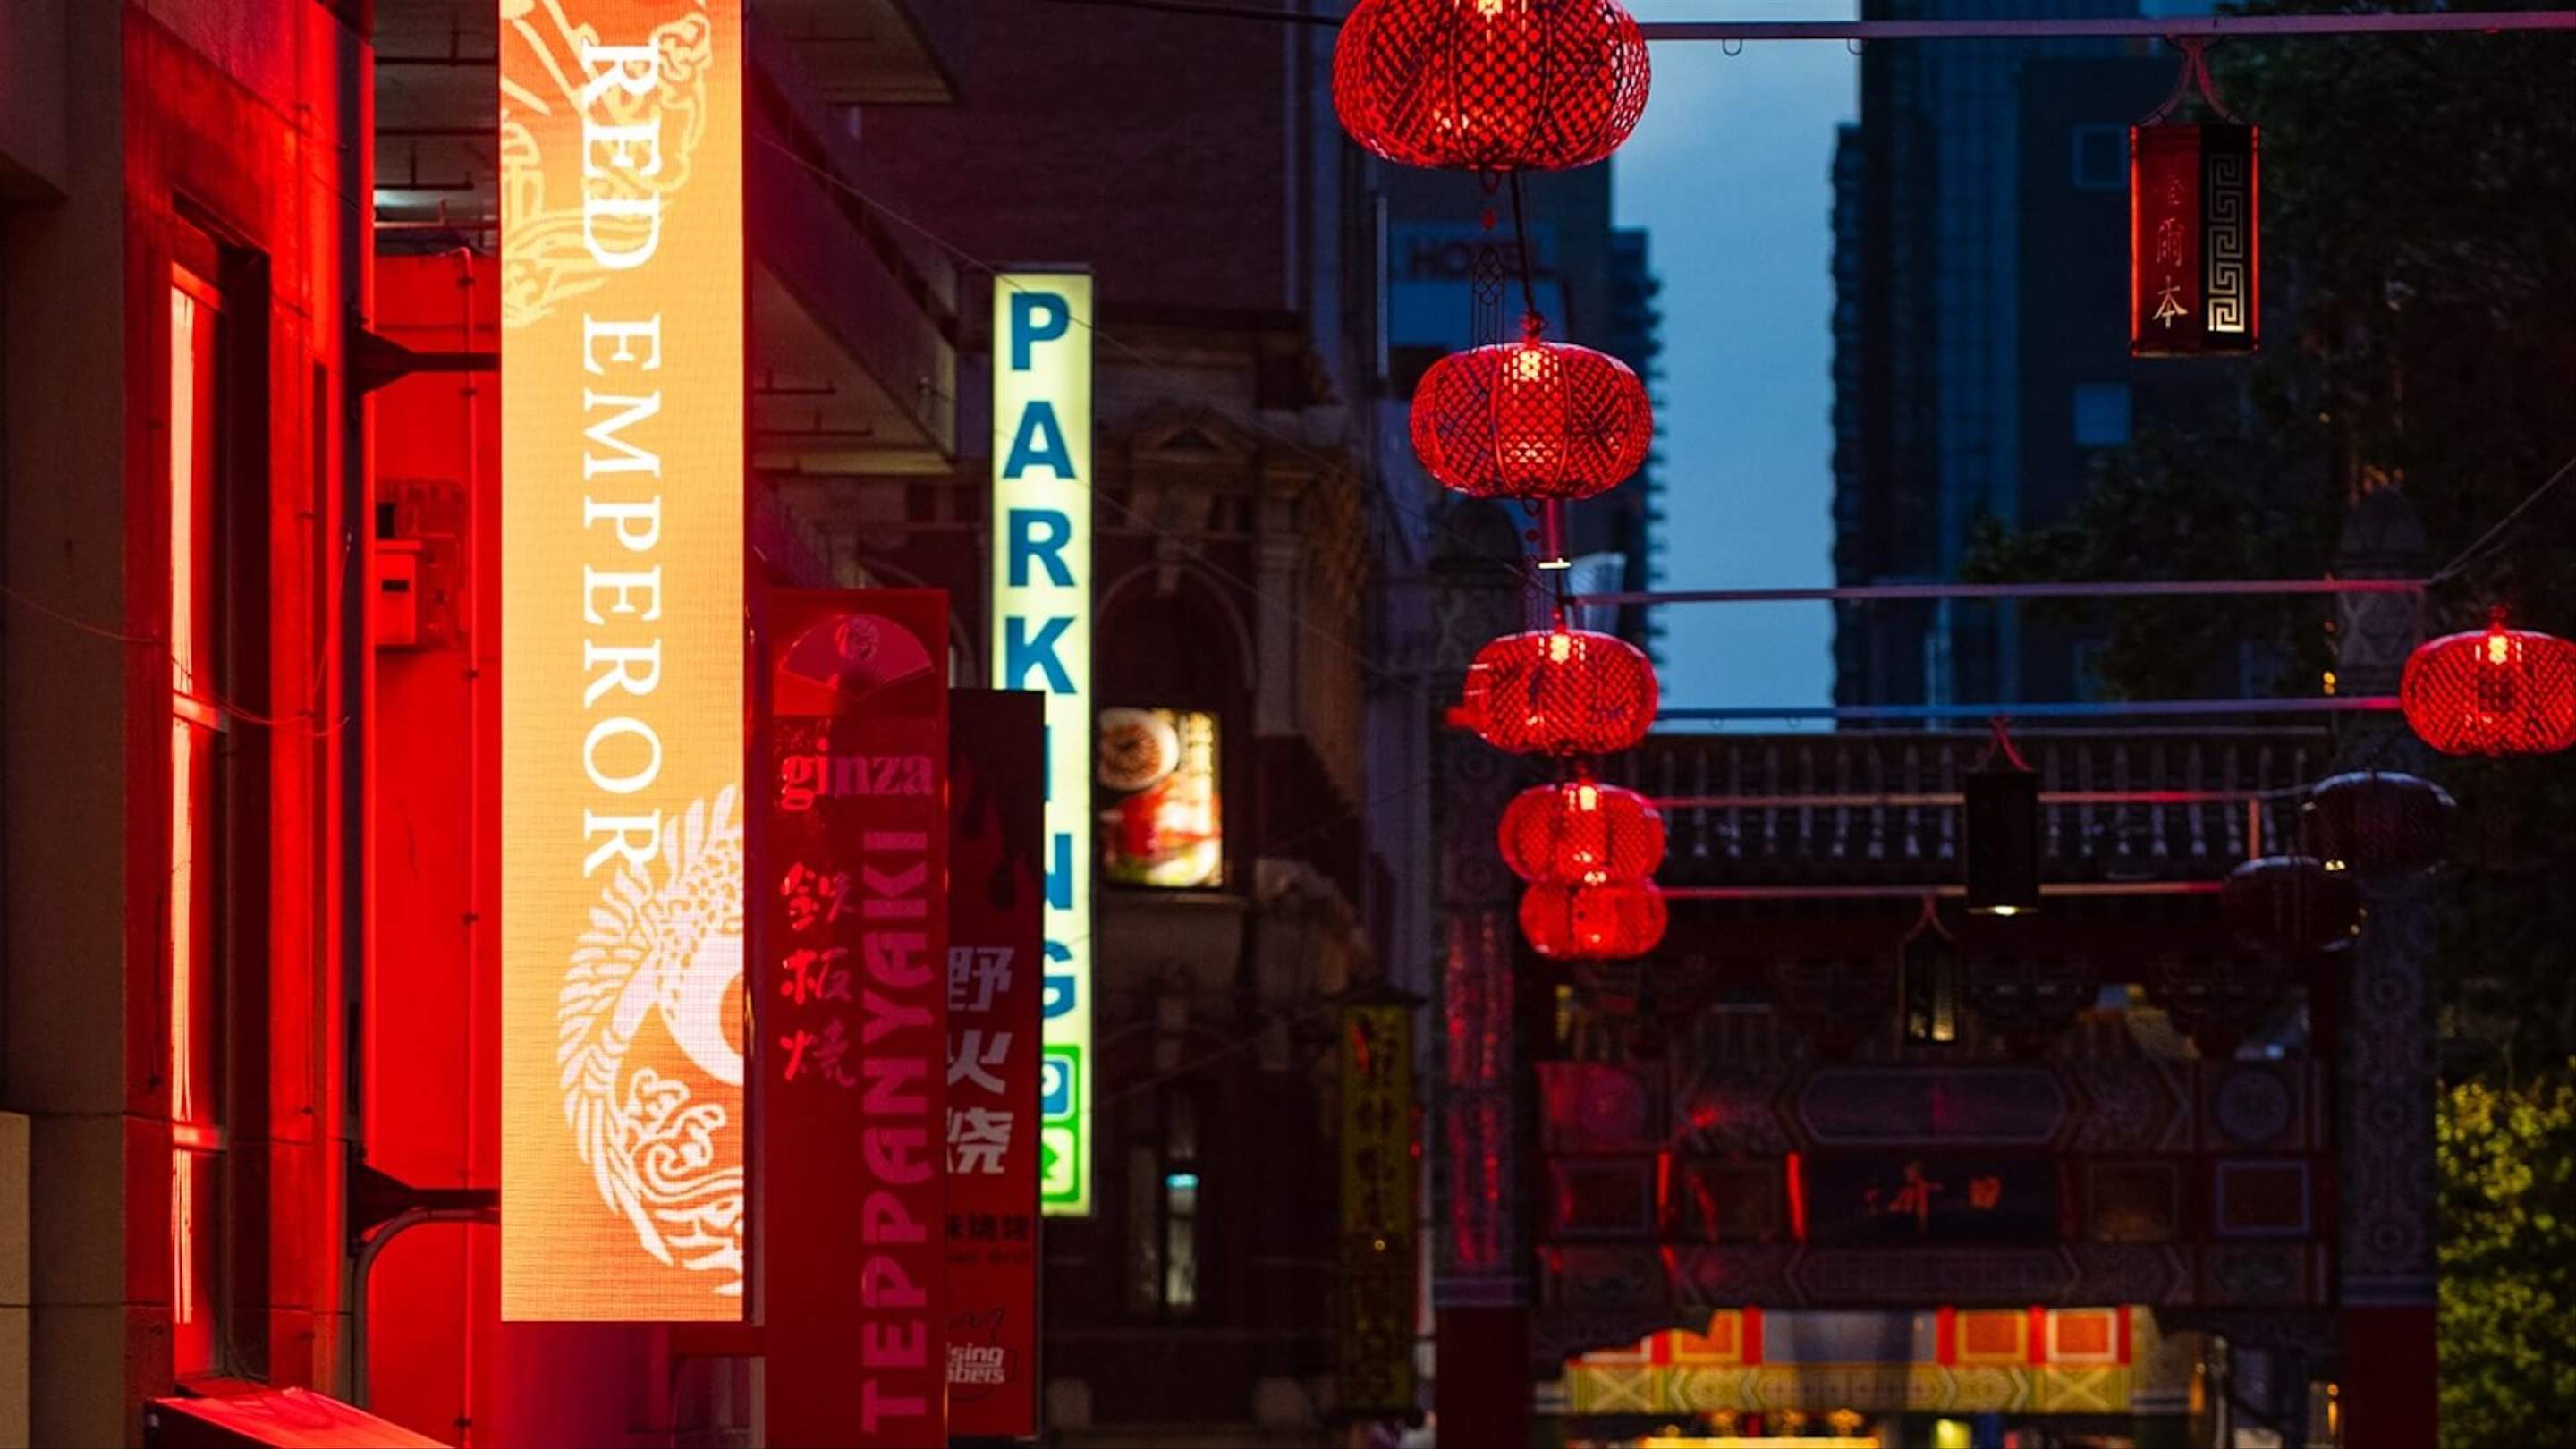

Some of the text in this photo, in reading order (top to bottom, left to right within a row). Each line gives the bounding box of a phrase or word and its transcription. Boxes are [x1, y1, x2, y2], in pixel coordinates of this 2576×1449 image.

[582, 38, 662, 879] RED EMPEROR
[1002, 292, 1078, 1019] PARK
[780, 737, 934, 811] ginza
[946, 946, 1014, 1174] 野火烧
[862, 831, 936, 1434] TEPPANYAKI
